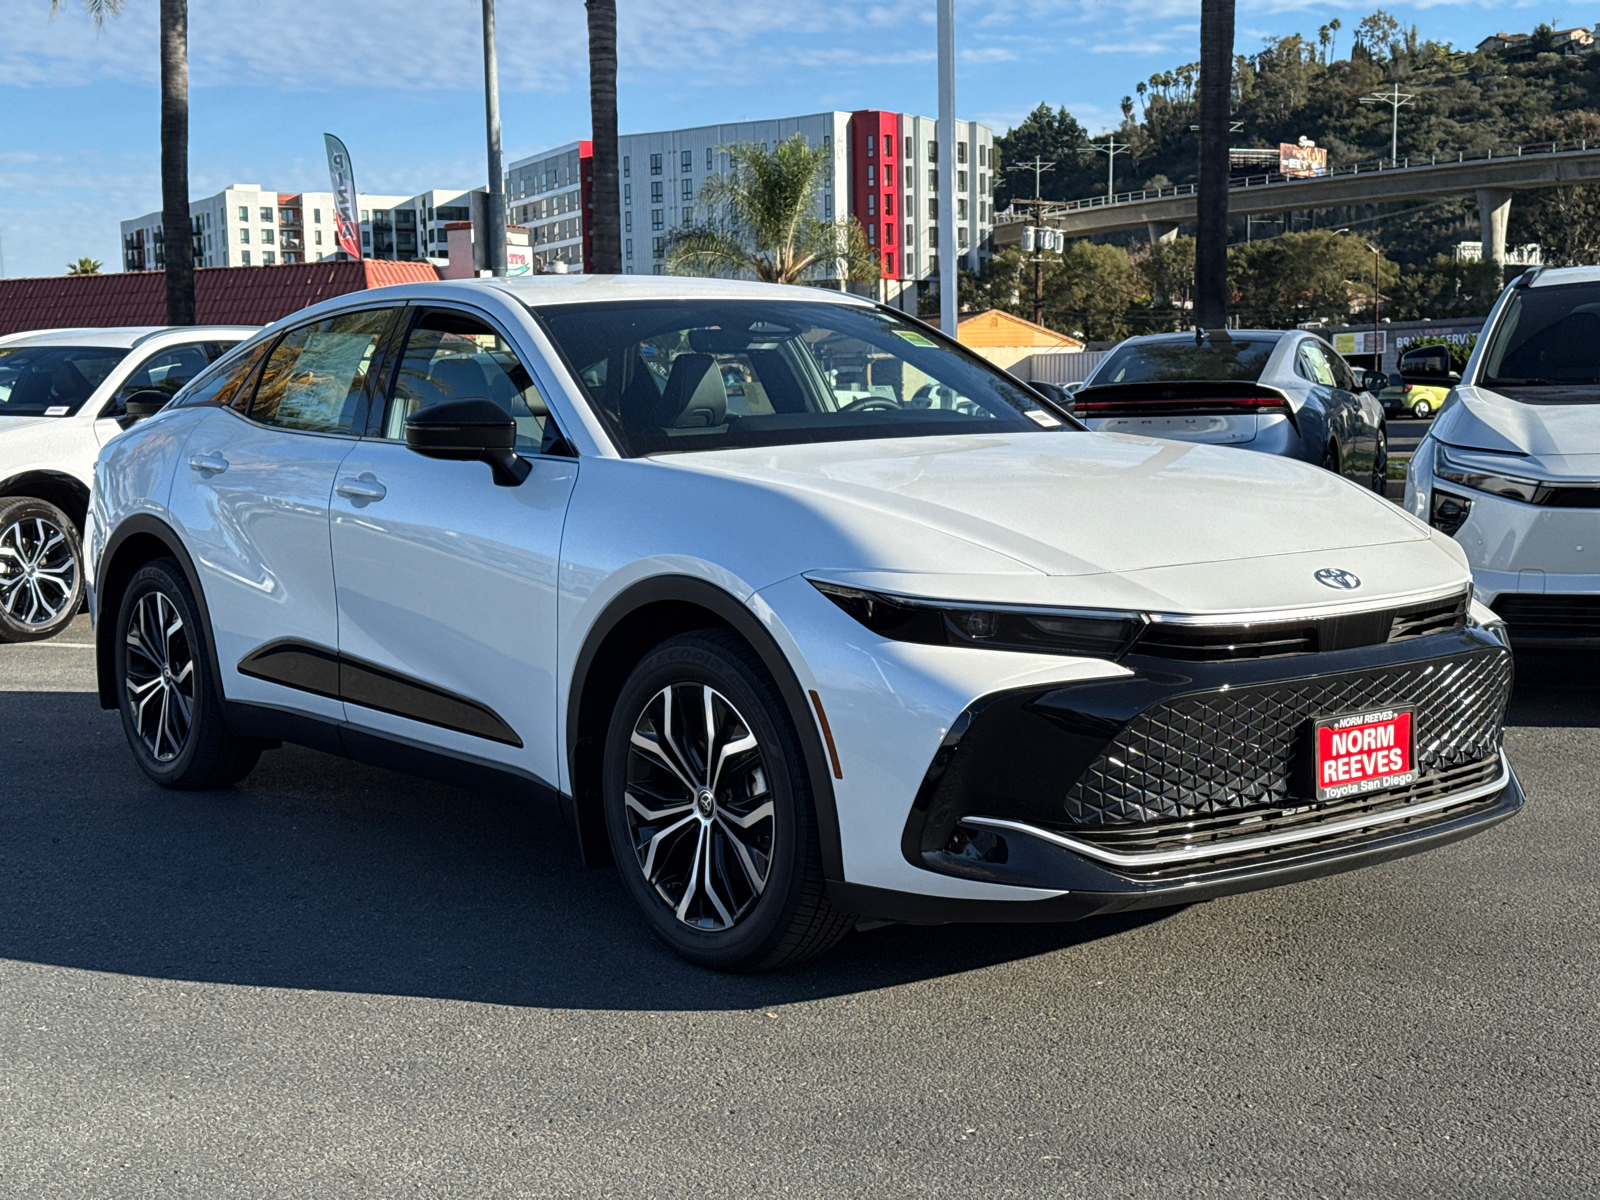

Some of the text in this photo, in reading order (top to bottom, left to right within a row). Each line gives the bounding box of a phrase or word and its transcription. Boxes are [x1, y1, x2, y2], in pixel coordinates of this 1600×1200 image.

[1339, 711, 1393, 728] NORM REEVES
[1332, 724, 1395, 756] NORM
[1323, 748, 1402, 783] REEVES
[1324, 774, 1412, 798] Toyota San Diego
